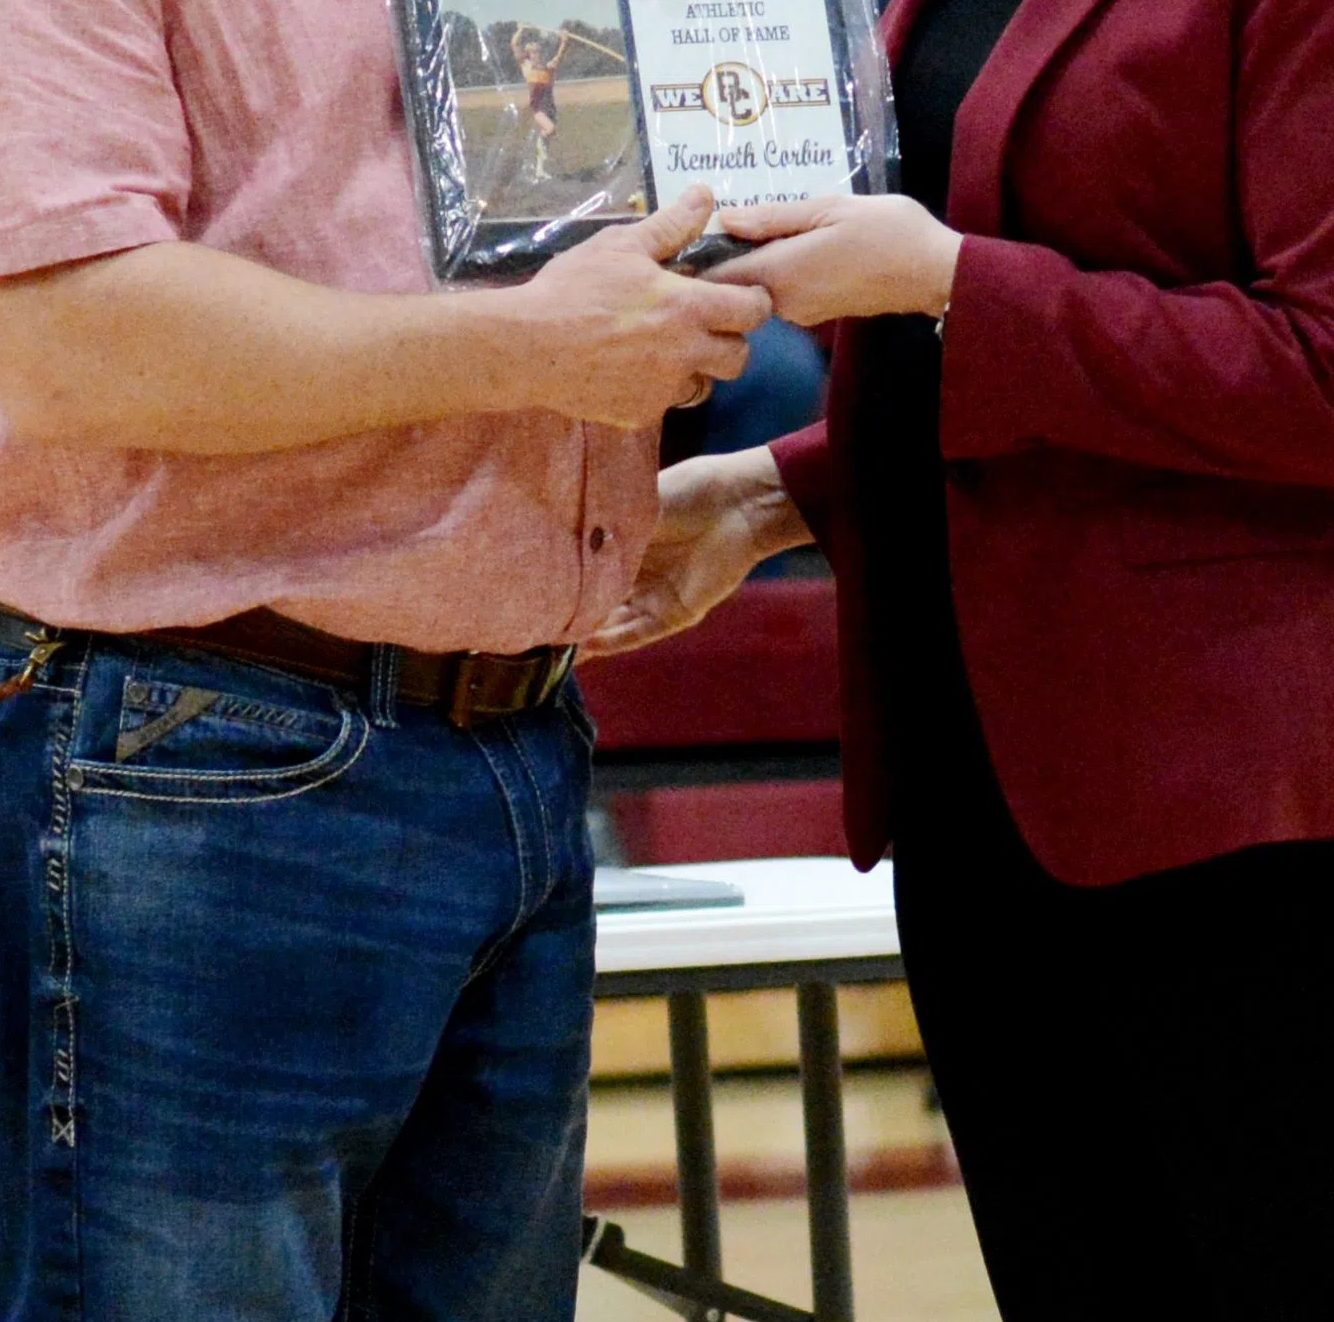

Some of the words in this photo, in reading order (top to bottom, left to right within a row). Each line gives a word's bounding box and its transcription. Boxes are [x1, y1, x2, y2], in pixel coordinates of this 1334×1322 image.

[686, 1, 765, 19] ATHLETIC
[672, 29, 715, 45] HALL
[719, 27, 740, 43] OF
[746, 25, 790, 42] FAME
[654, 87, 702, 109] WE
[667, 141, 758, 172] Kenneth
[763, 138, 834, 169] Corbin
